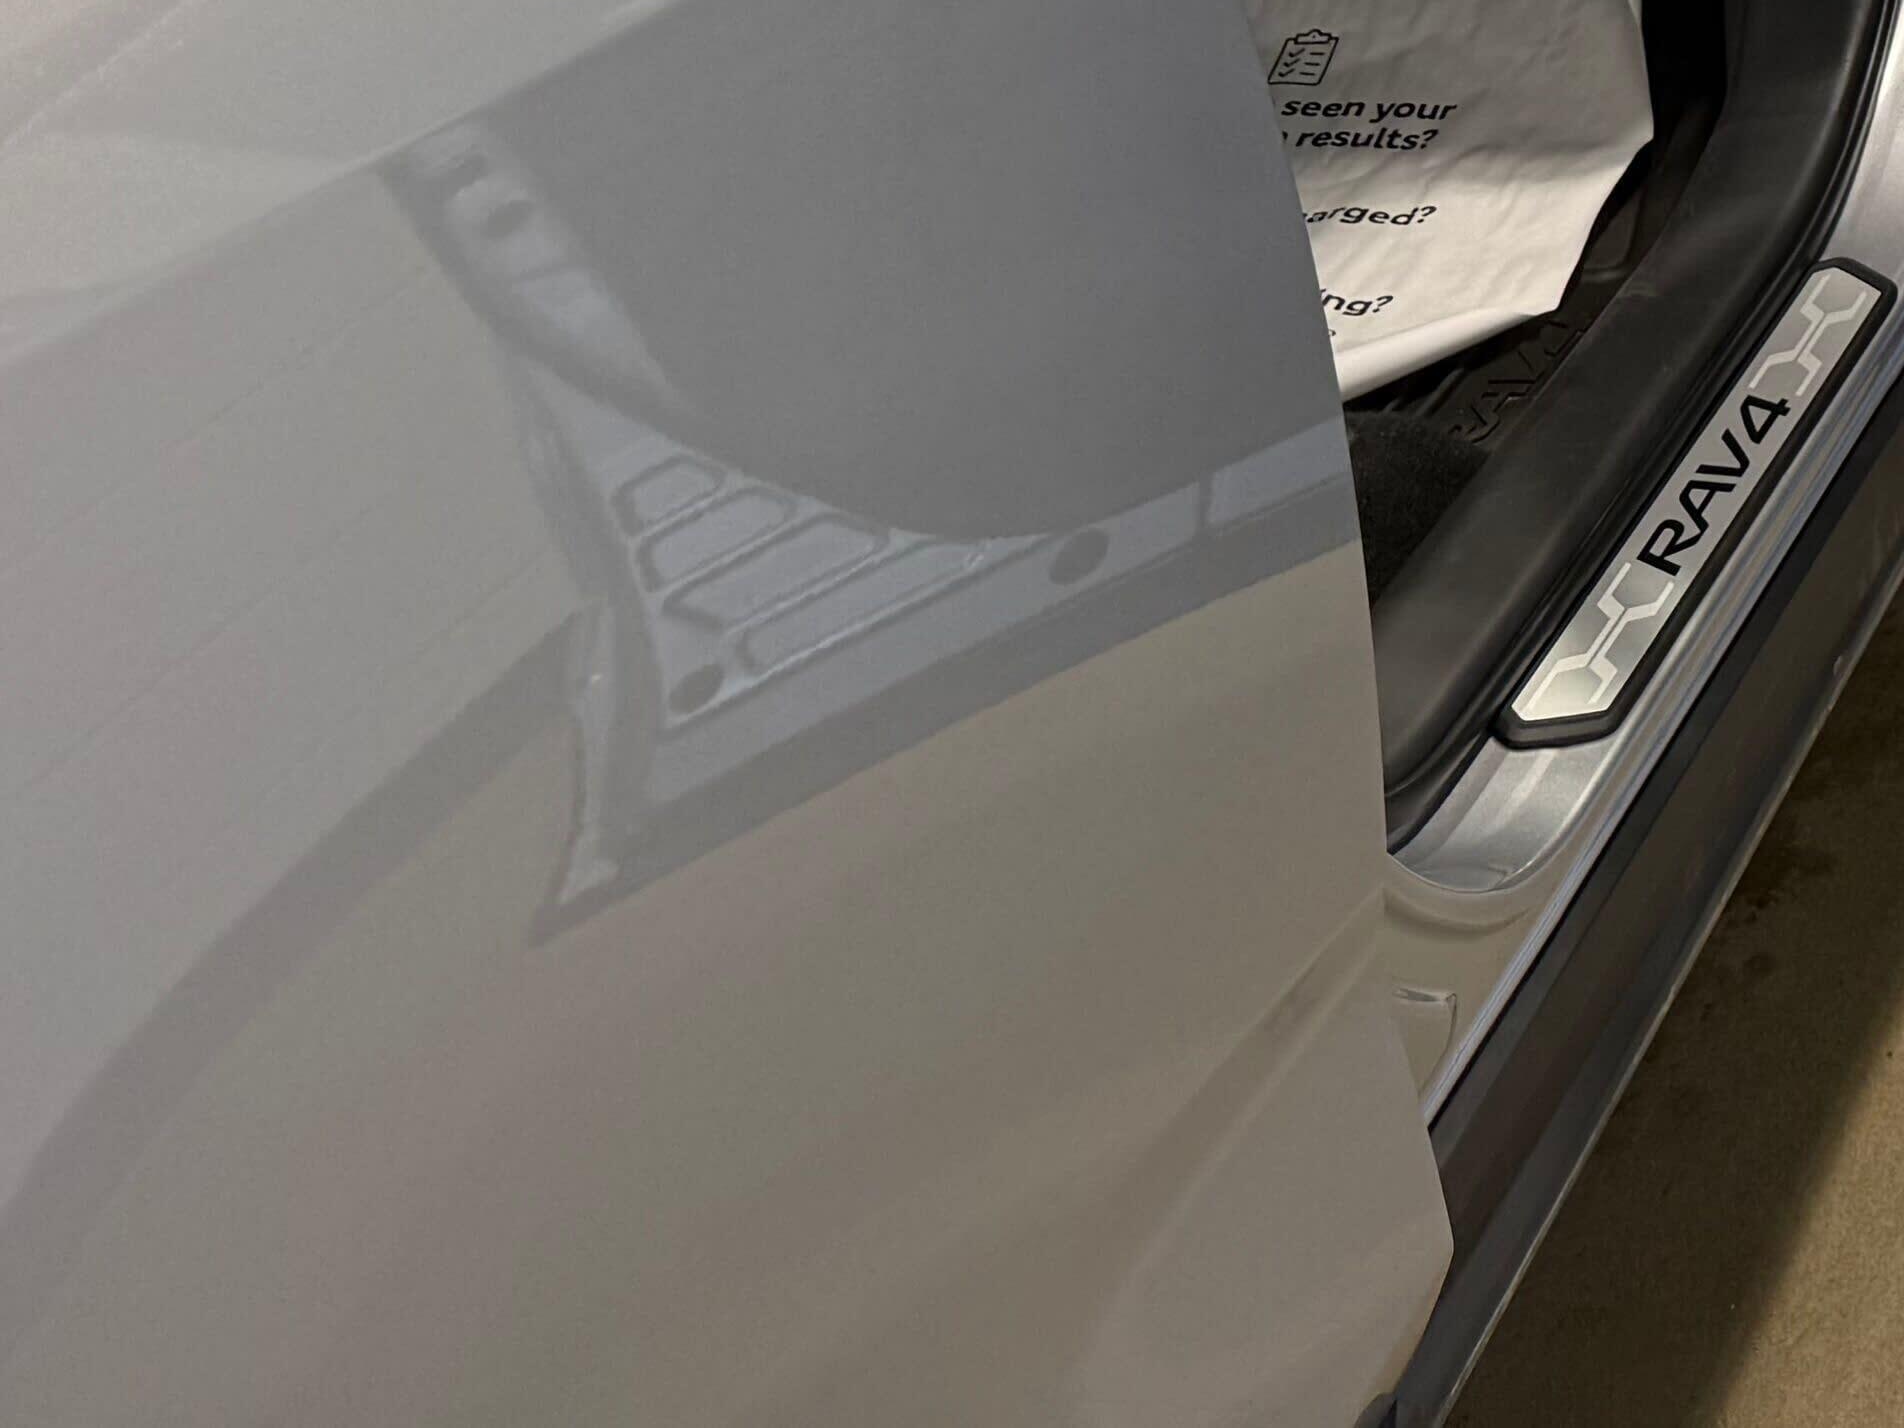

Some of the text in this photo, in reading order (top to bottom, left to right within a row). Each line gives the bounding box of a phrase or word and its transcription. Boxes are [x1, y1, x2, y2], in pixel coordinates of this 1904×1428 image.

[1281, 100, 1457, 124] seen your
[1295, 127, 1439, 151] results?
[1636, 394, 1791, 577] RAV4
